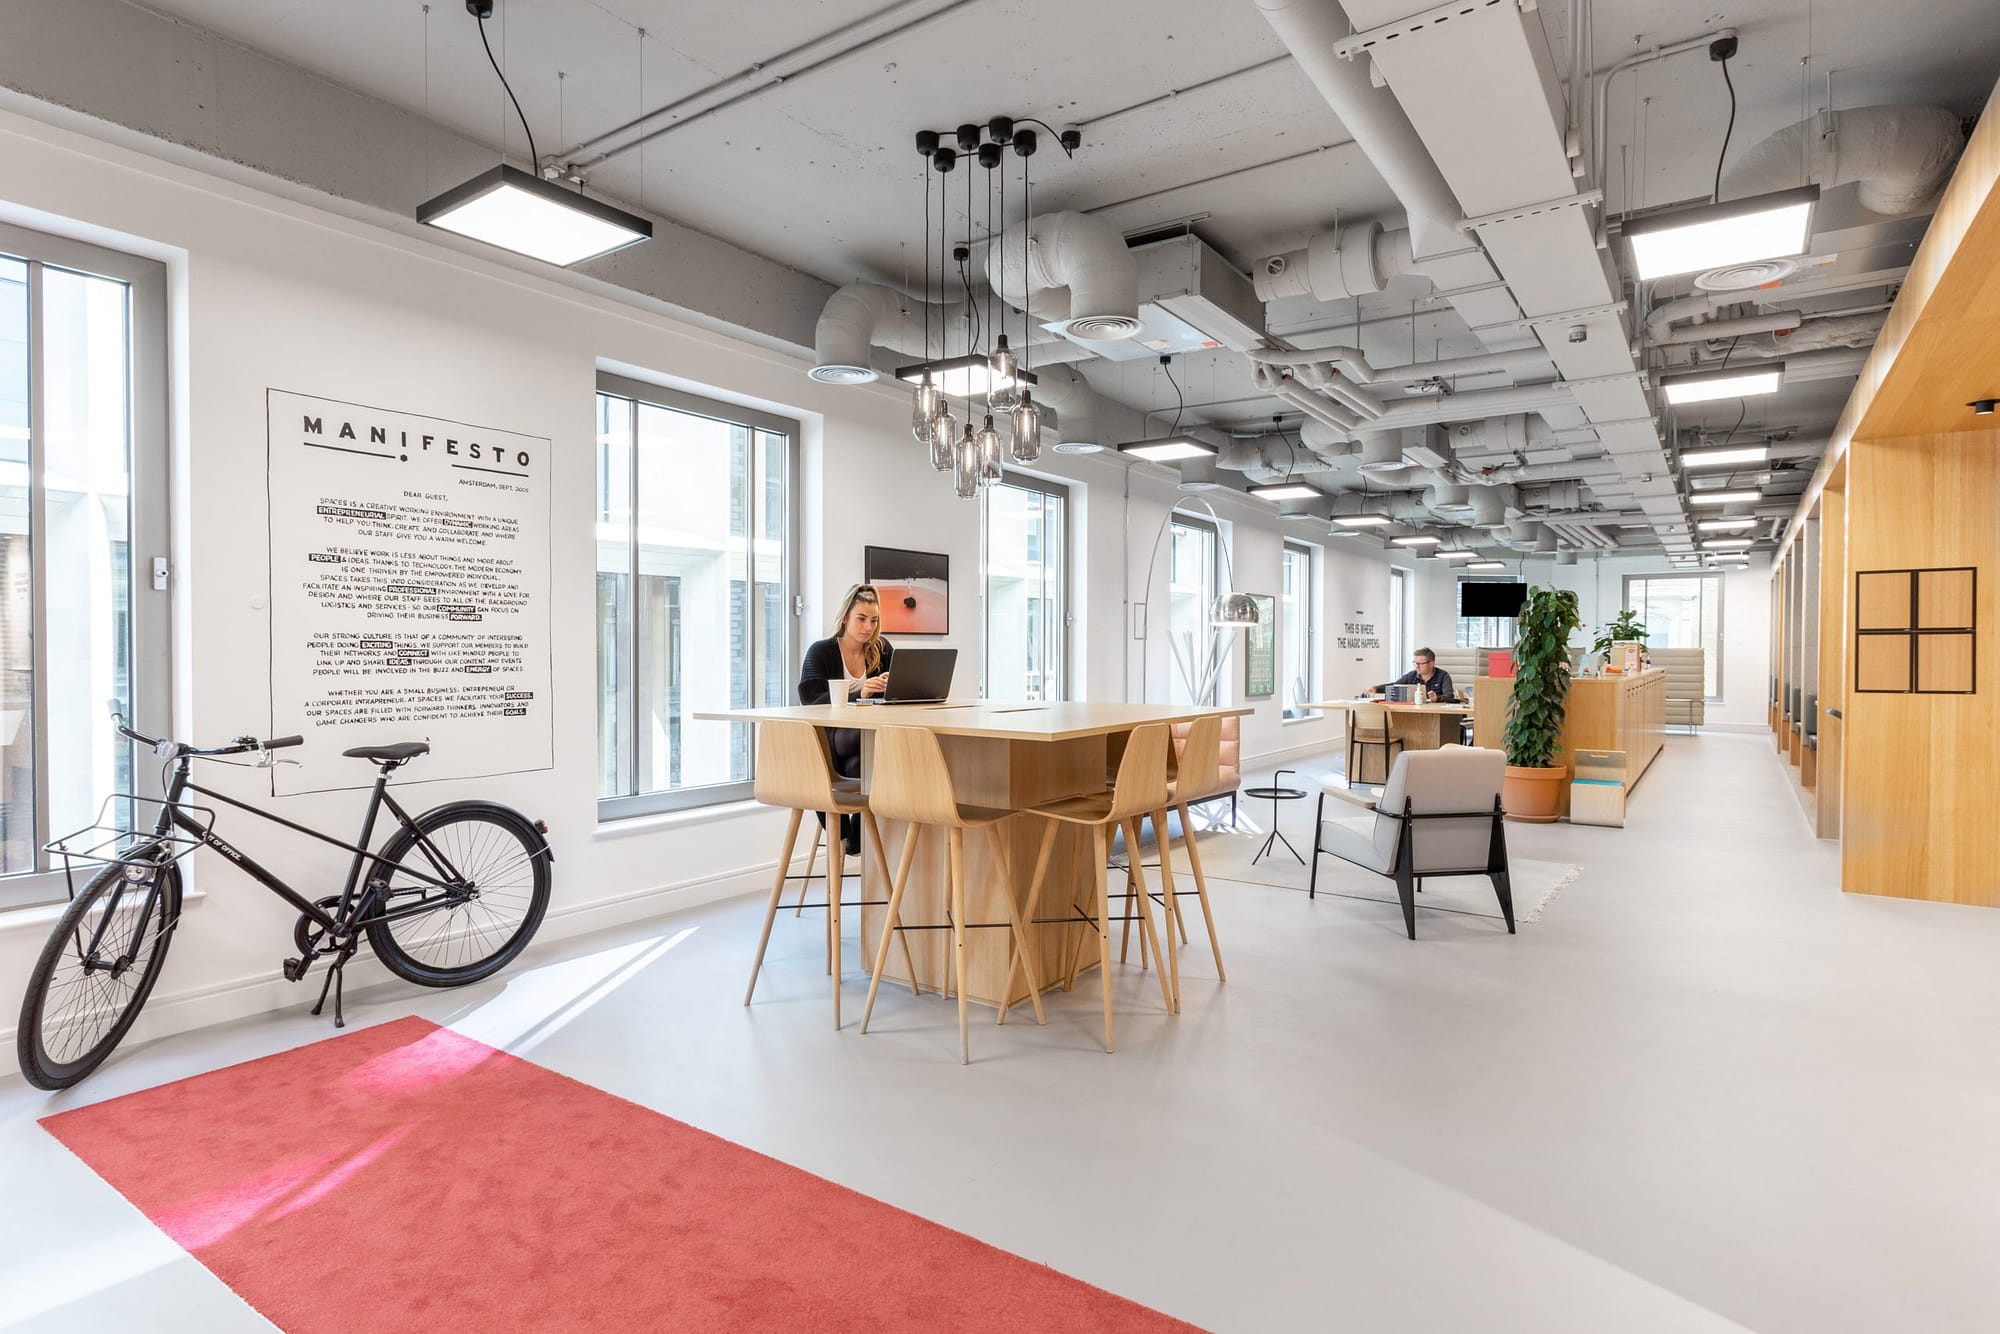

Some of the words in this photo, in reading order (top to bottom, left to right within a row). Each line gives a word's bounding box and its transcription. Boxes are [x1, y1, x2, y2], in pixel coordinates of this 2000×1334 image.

[304, 415, 530, 467] MANIFESTO
[318, 506, 386, 520] ENTREPRENEURIAL
[320, 498, 347, 506] SPACES
[366, 503, 397, 511] CREATIVE
[431, 510, 474, 519] ENVIRONMENT
[439, 528, 478, 536] COLLABORATE
[310, 554, 340, 563] PEOPLE
